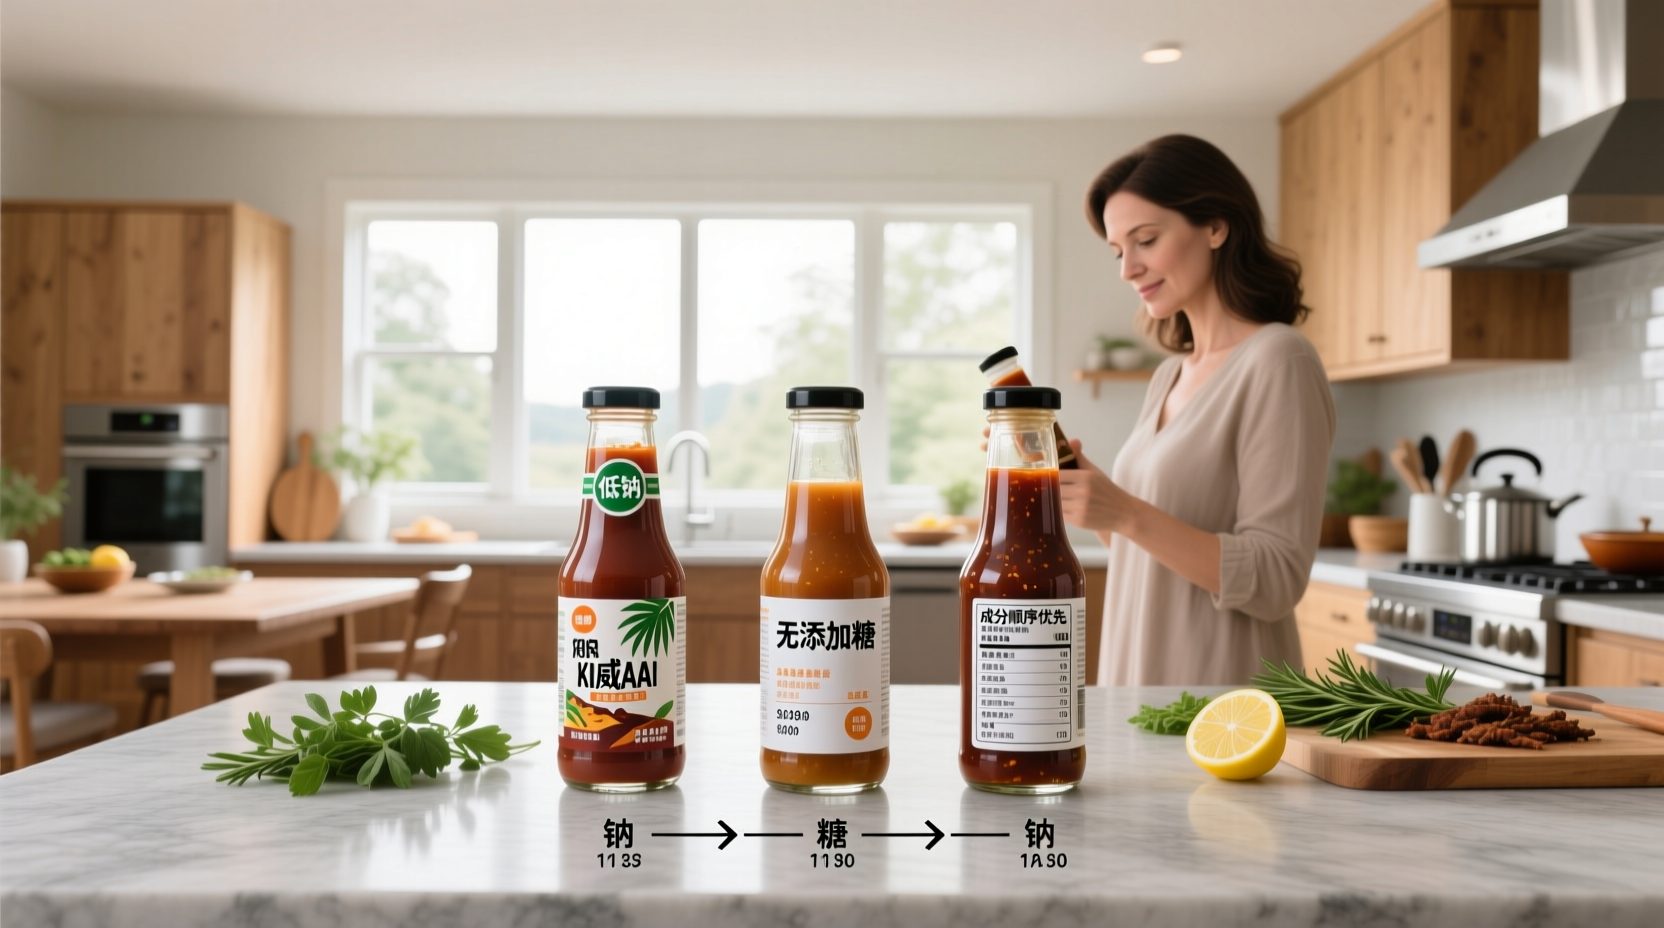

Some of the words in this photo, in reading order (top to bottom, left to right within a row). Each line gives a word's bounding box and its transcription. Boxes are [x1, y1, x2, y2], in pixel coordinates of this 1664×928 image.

[598, 475, 641, 499] 低钠
[980, 607, 1067, 625] 成分顺序优先
[776, 620, 876, 651] 无添加糖
